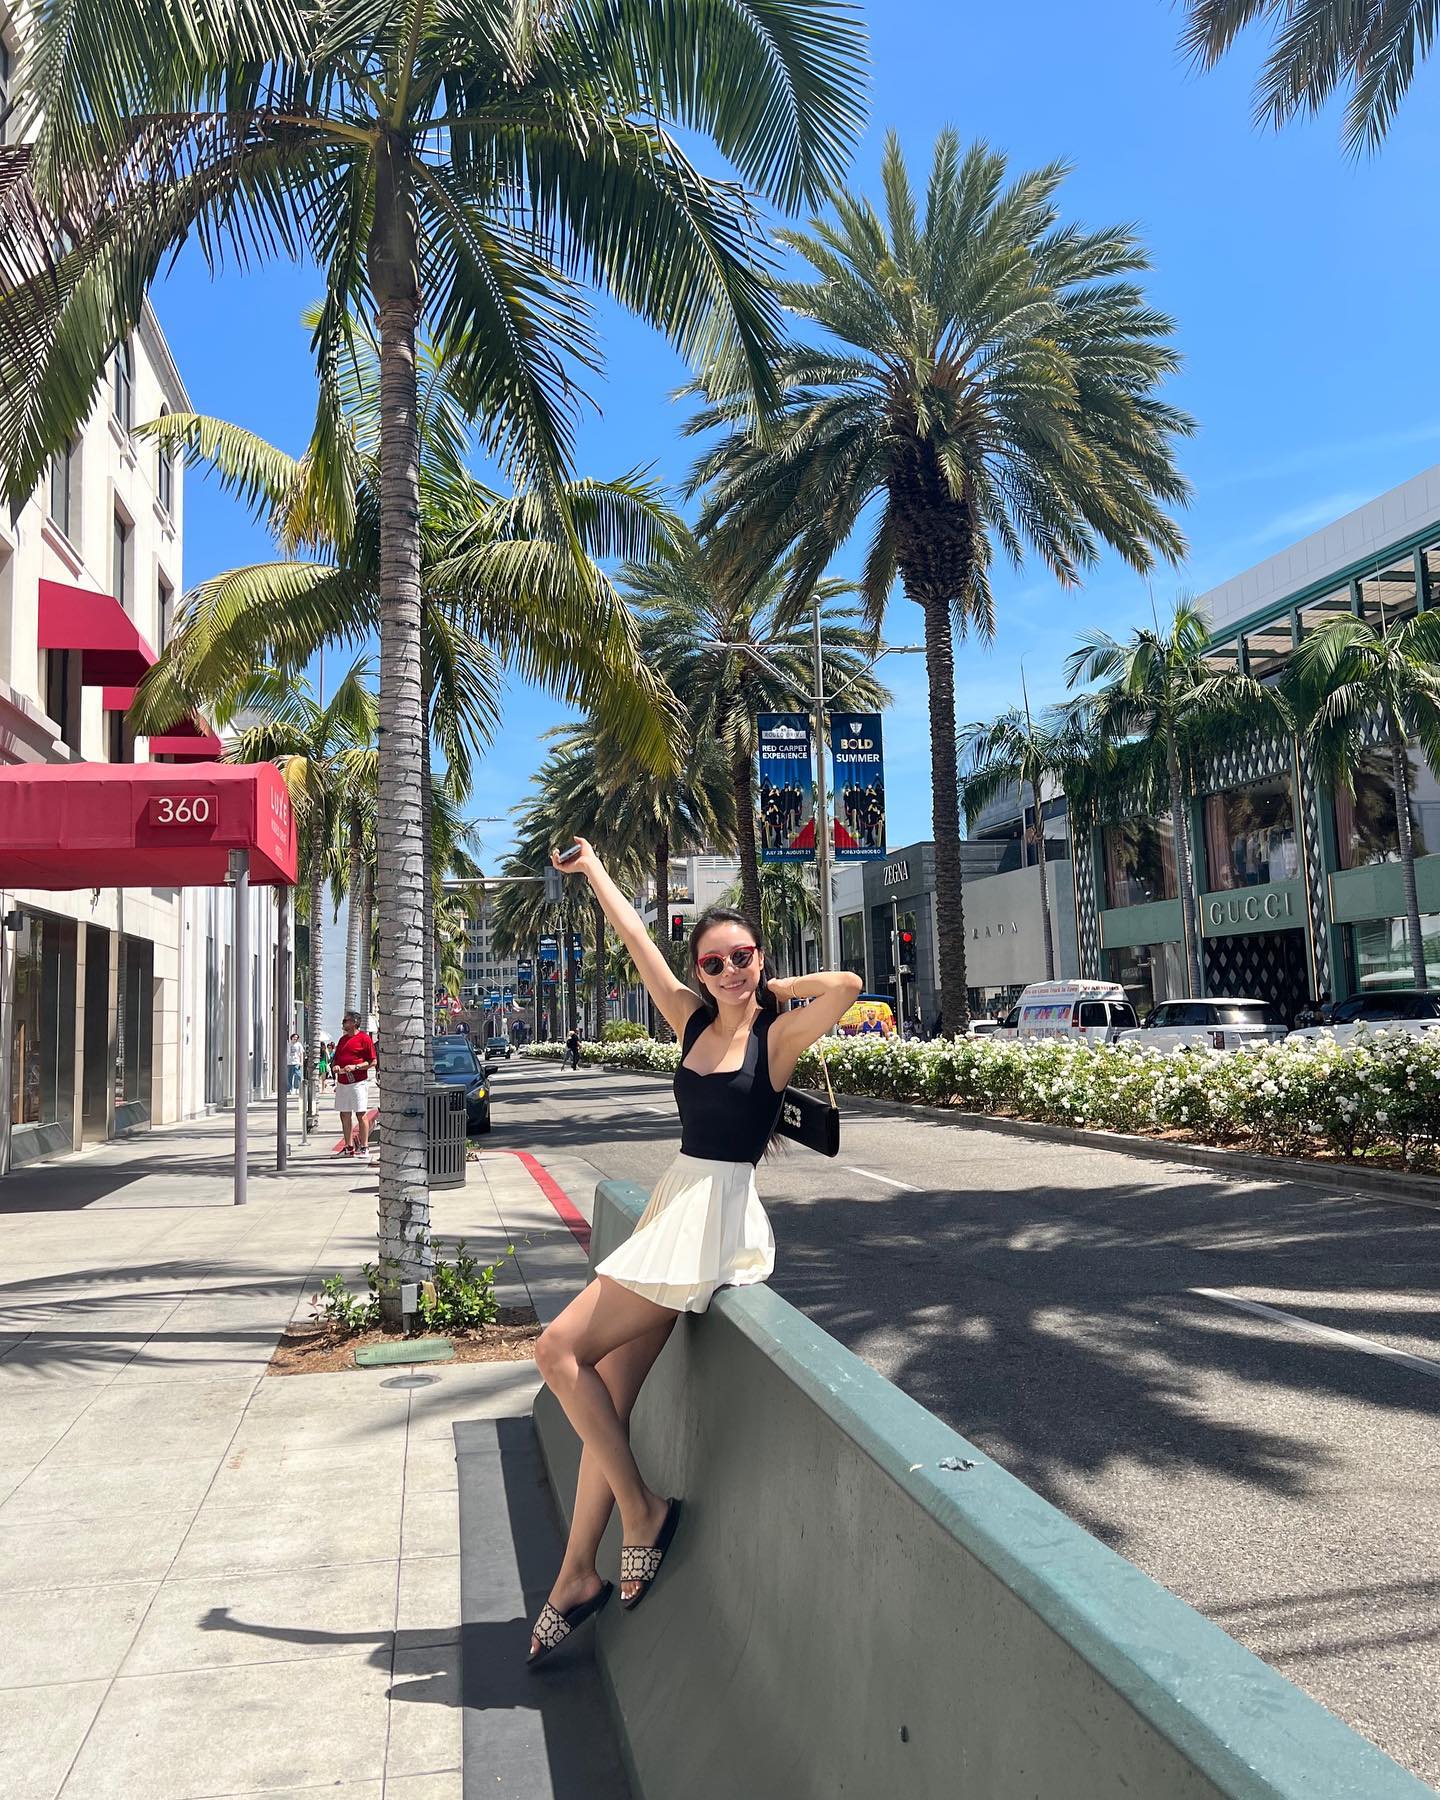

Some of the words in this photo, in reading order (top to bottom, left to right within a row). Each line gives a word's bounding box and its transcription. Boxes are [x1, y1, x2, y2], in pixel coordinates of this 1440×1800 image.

[841, 739, 873, 750] BOLD
[762, 752, 808, 760] EXPERIENCE
[836, 753, 880, 763] SUMMER
[158, 797, 209, 823] 360
[271, 785, 287, 826] LUXE
[883, 860, 909, 886] ZEGNA
[1210, 892, 1292, 926] GUCCI
[963, 921, 1018, 940] RADA
